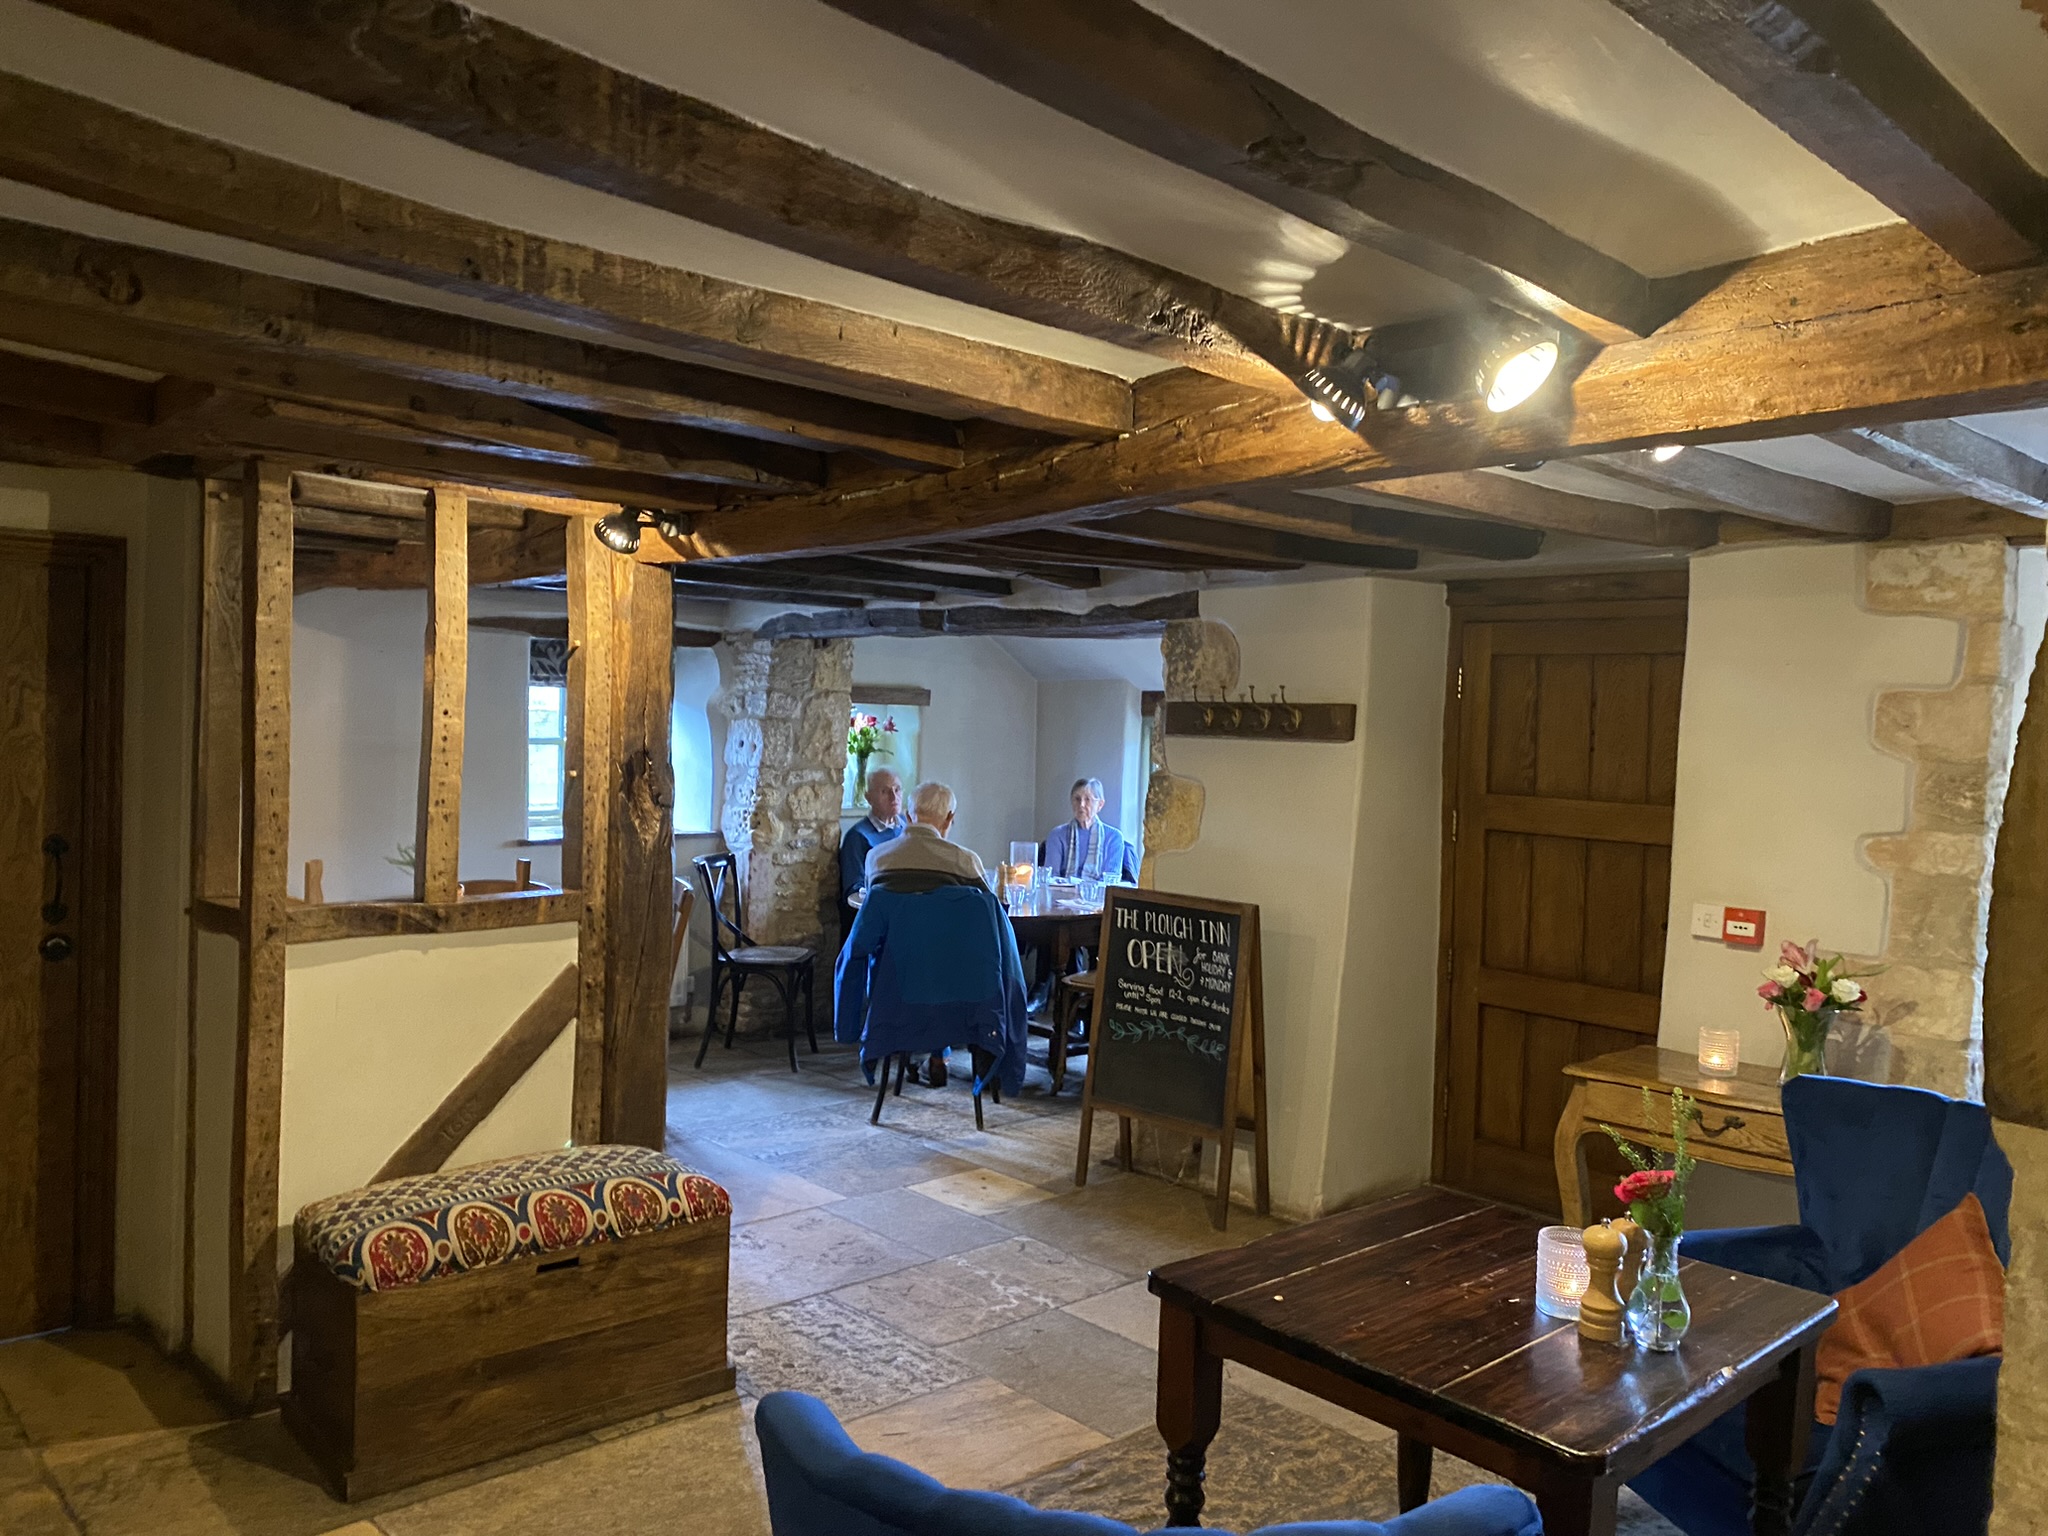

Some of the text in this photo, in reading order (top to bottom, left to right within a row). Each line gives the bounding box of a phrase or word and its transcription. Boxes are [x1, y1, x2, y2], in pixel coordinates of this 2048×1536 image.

[1115, 906, 1231, 947] THE PLOUGH INN
[1127, 939, 1195, 990] OPEN
[1200, 961, 1226, 977] HOLIDAY
